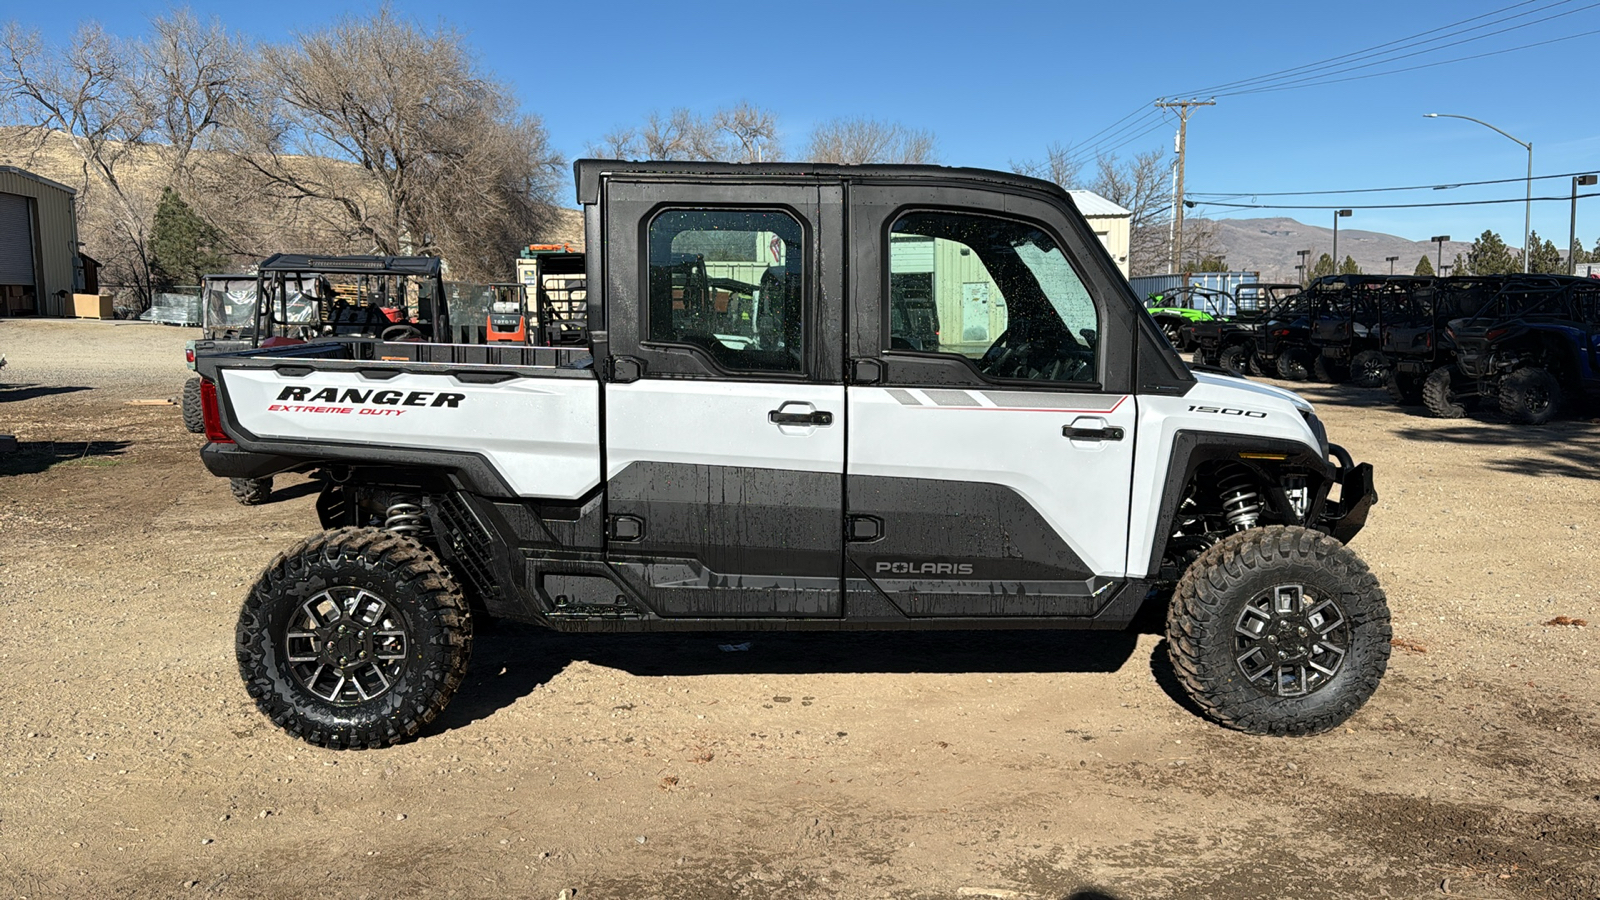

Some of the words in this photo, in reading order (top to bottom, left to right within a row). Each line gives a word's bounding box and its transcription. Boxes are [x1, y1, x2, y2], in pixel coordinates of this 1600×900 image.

[276, 385, 466, 408] RANGER
[268, 404, 354, 414] EXTREME
[358, 408, 407, 416] DUTY
[1188, 405, 1268, 418] 1500
[875, 562, 974, 575] POLARIS
